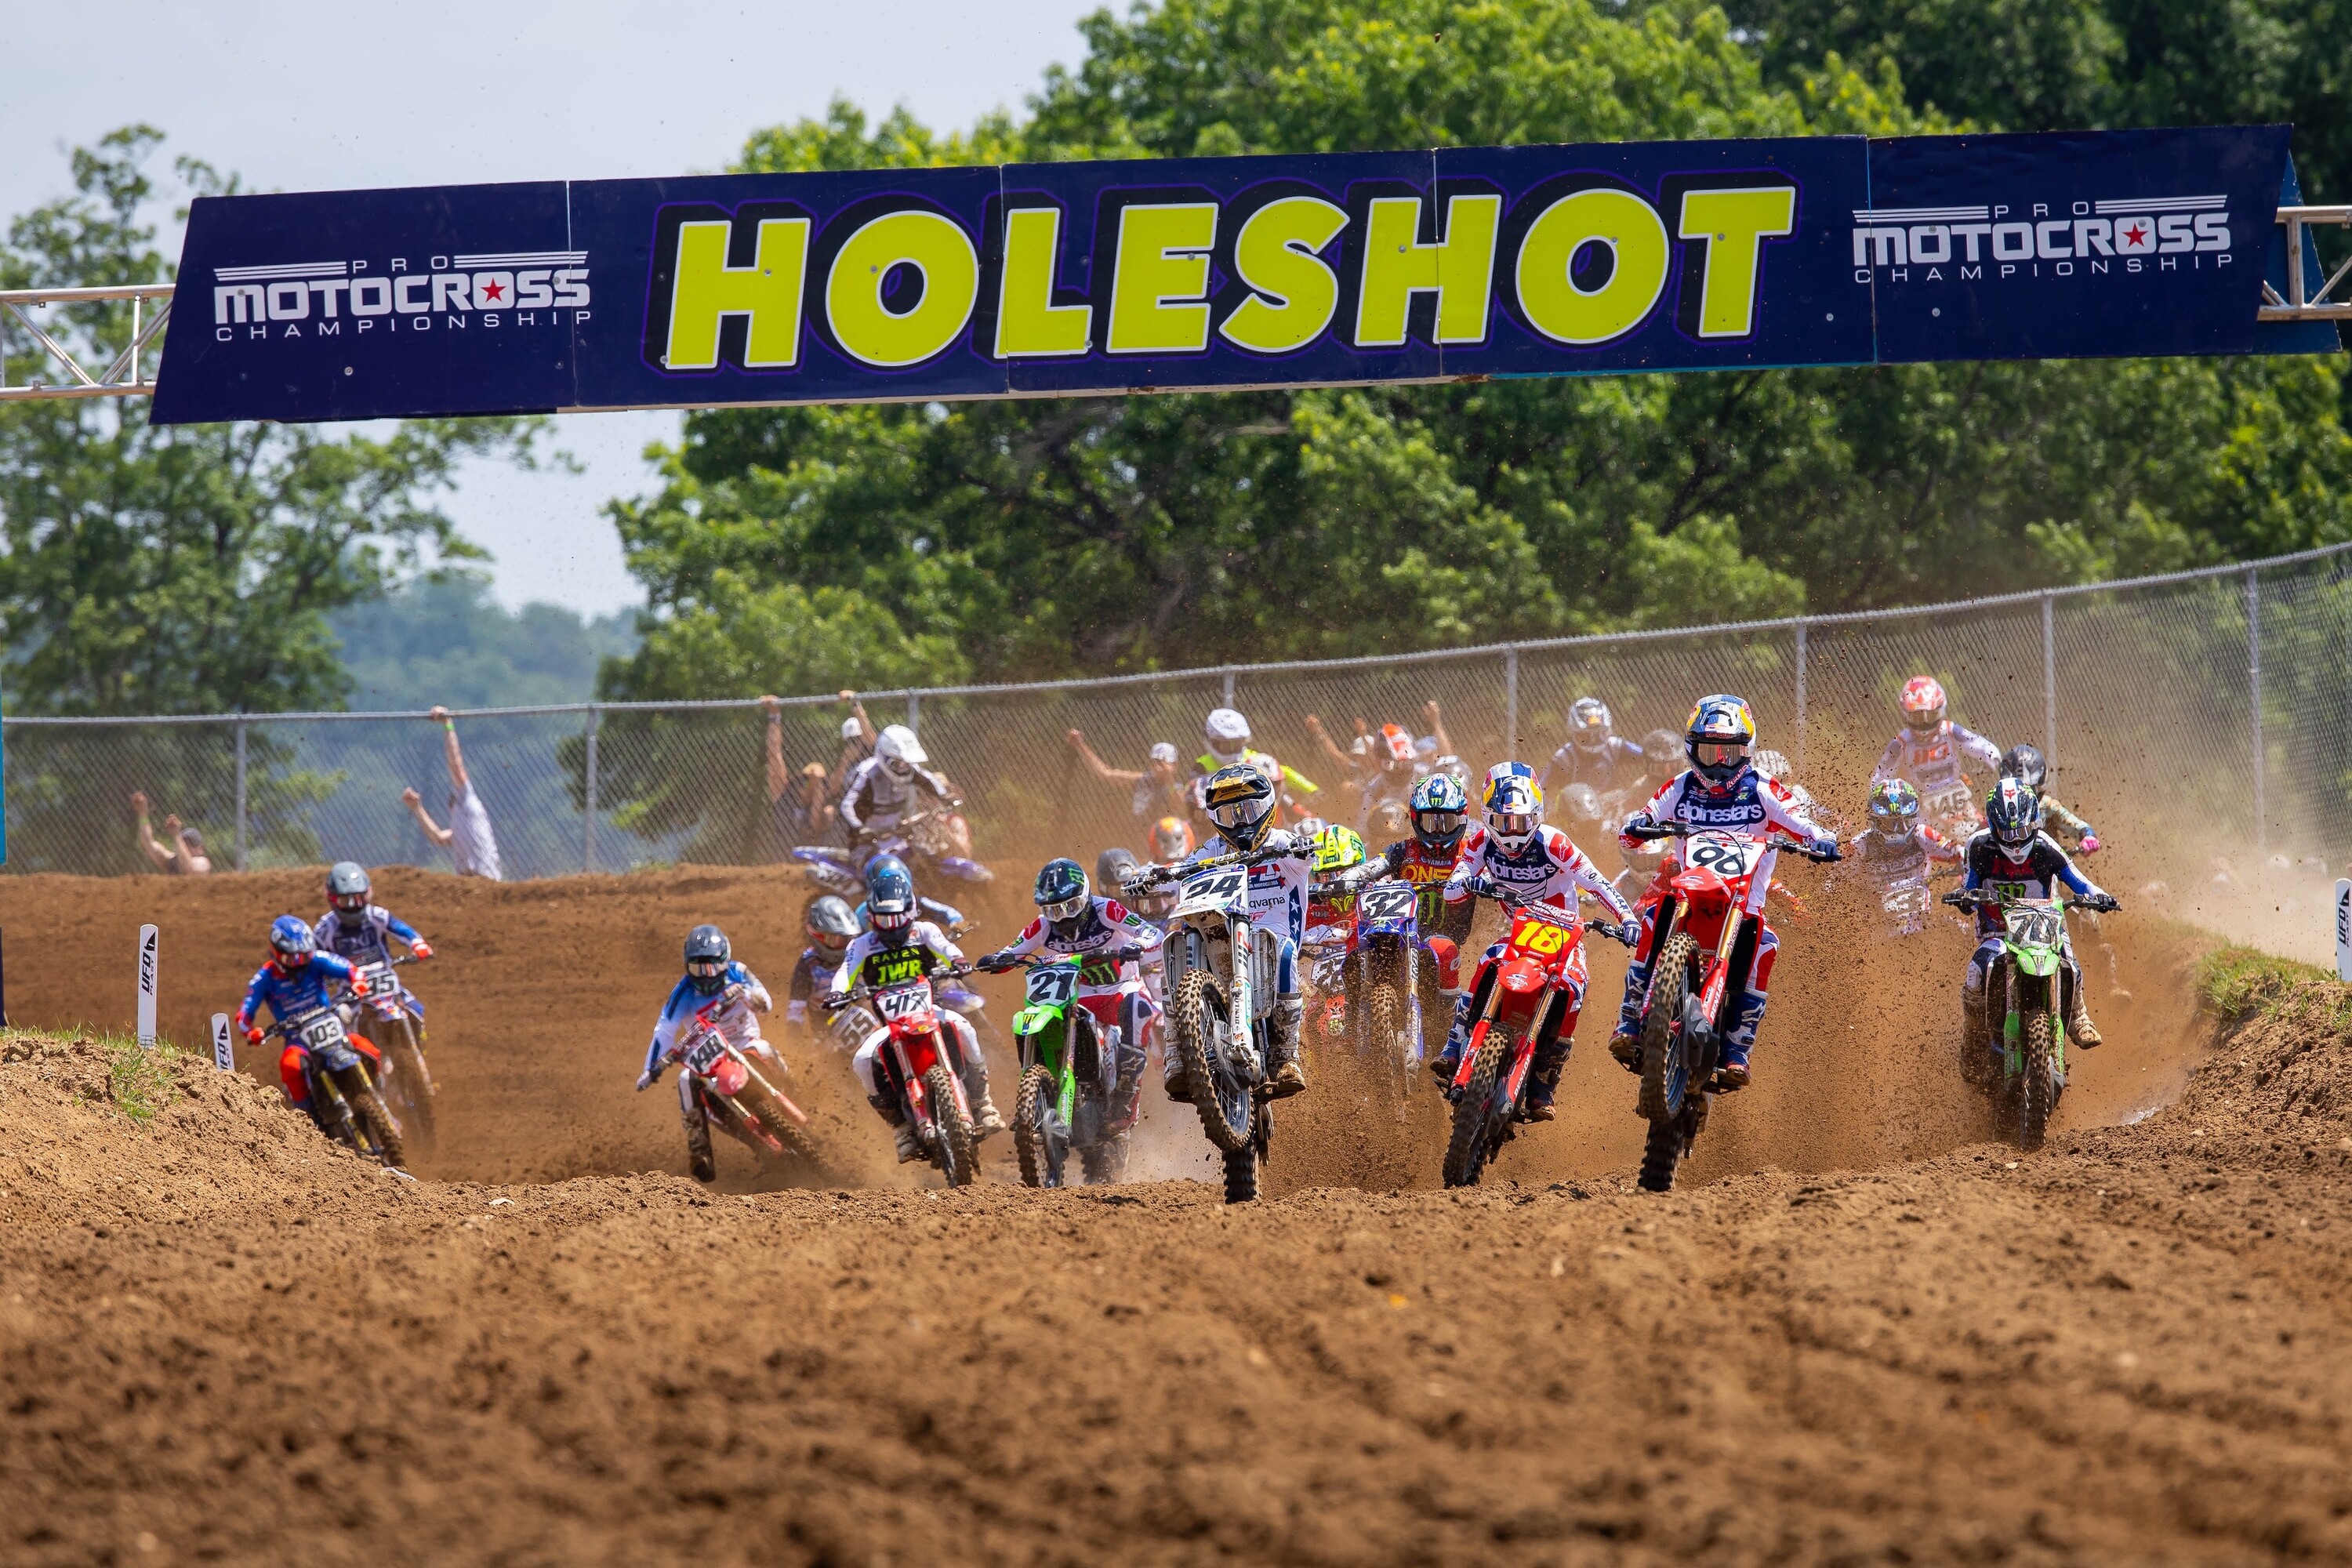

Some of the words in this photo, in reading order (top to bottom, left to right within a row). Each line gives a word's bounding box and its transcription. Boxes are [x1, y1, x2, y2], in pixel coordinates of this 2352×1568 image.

[1994, 200, 2089, 217] PRO
[1852, 212, 2230, 266] MOTOCROSS
[352, 255, 449, 273] PRO
[663, 185, 1796, 371] HOLESHOT
[1854, 254, 2232, 284] CHAMPIONSHIP
[214, 268, 590, 325] MOTOCROSS
[216, 310, 592, 342] CHAMPIONSHIP
[1677, 800, 1762, 822] alpinestars
[1486, 856, 1556, 880] alpinestars
[1692, 846, 1747, 875] 96
[1184, 874, 1243, 901] 24
[1248, 896, 1286, 909] qvarna
[1362, 891, 1414, 920] 32
[1514, 921, 1571, 954] 18
[2338, 906, 2347, 946] UFO
[872, 947, 920, 965] RAVEN
[141, 951, 151, 994] UFO
[877, 959, 924, 985] JWR
[1029, 971, 1076, 1003] 21
[1709, 976, 1725, 1022] DUNLOP
[884, 990, 928, 1017] 417
[306, 1020, 339, 1048] 103
[1513, 1053, 1531, 1098] DUNLOP
